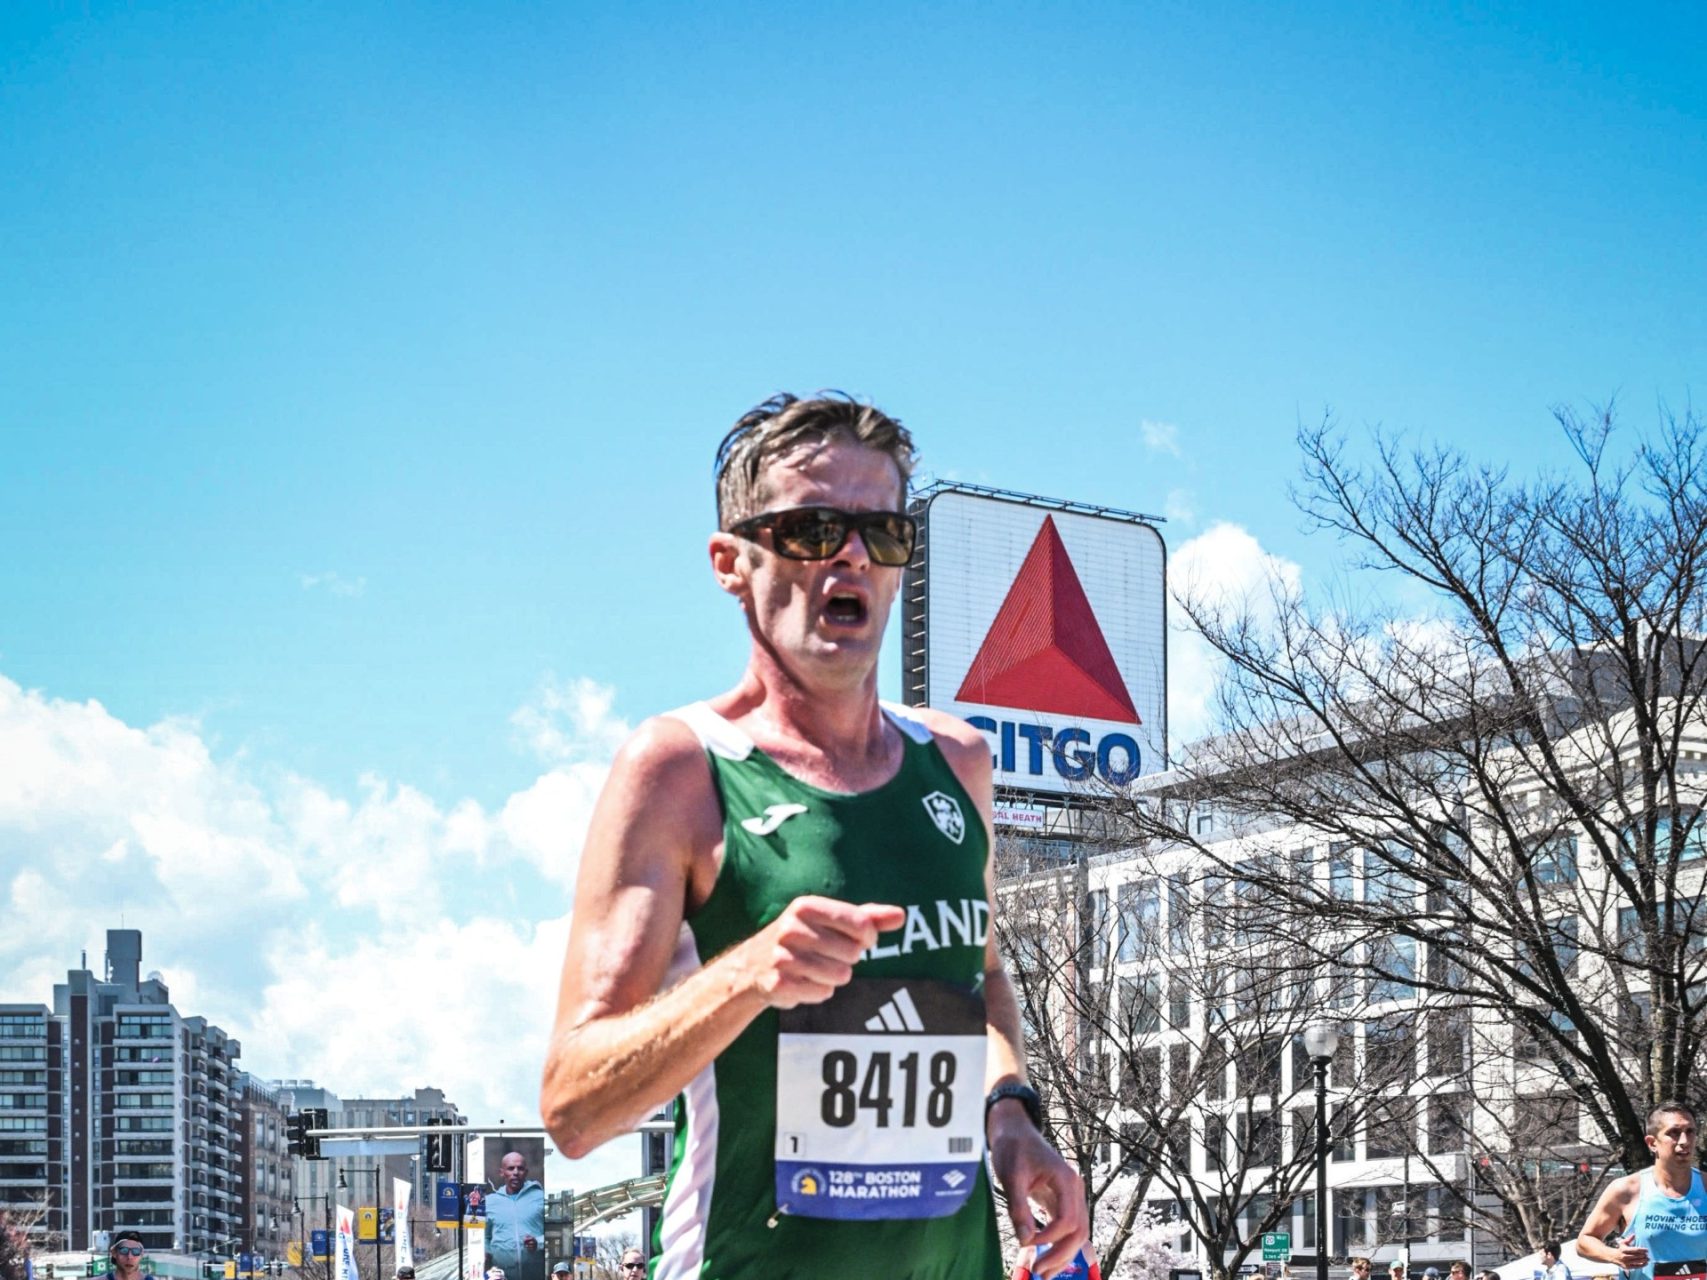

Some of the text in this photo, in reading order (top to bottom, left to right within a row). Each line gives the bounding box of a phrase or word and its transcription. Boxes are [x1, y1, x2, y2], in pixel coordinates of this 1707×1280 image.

[1012, 813, 1042, 823] HEATH
[860, 899, 989, 961] LAND
[821, 1049, 957, 1128] 8418
[789, 1136, 799, 1153] 1
[865, 1171, 921, 1185] BOSTON
[829, 1184, 921, 1199] MARATHON
[1645, 1214, 1678, 1223] MOVIN'
[1645, 1222, 1707, 1231] RUNNING CLU
